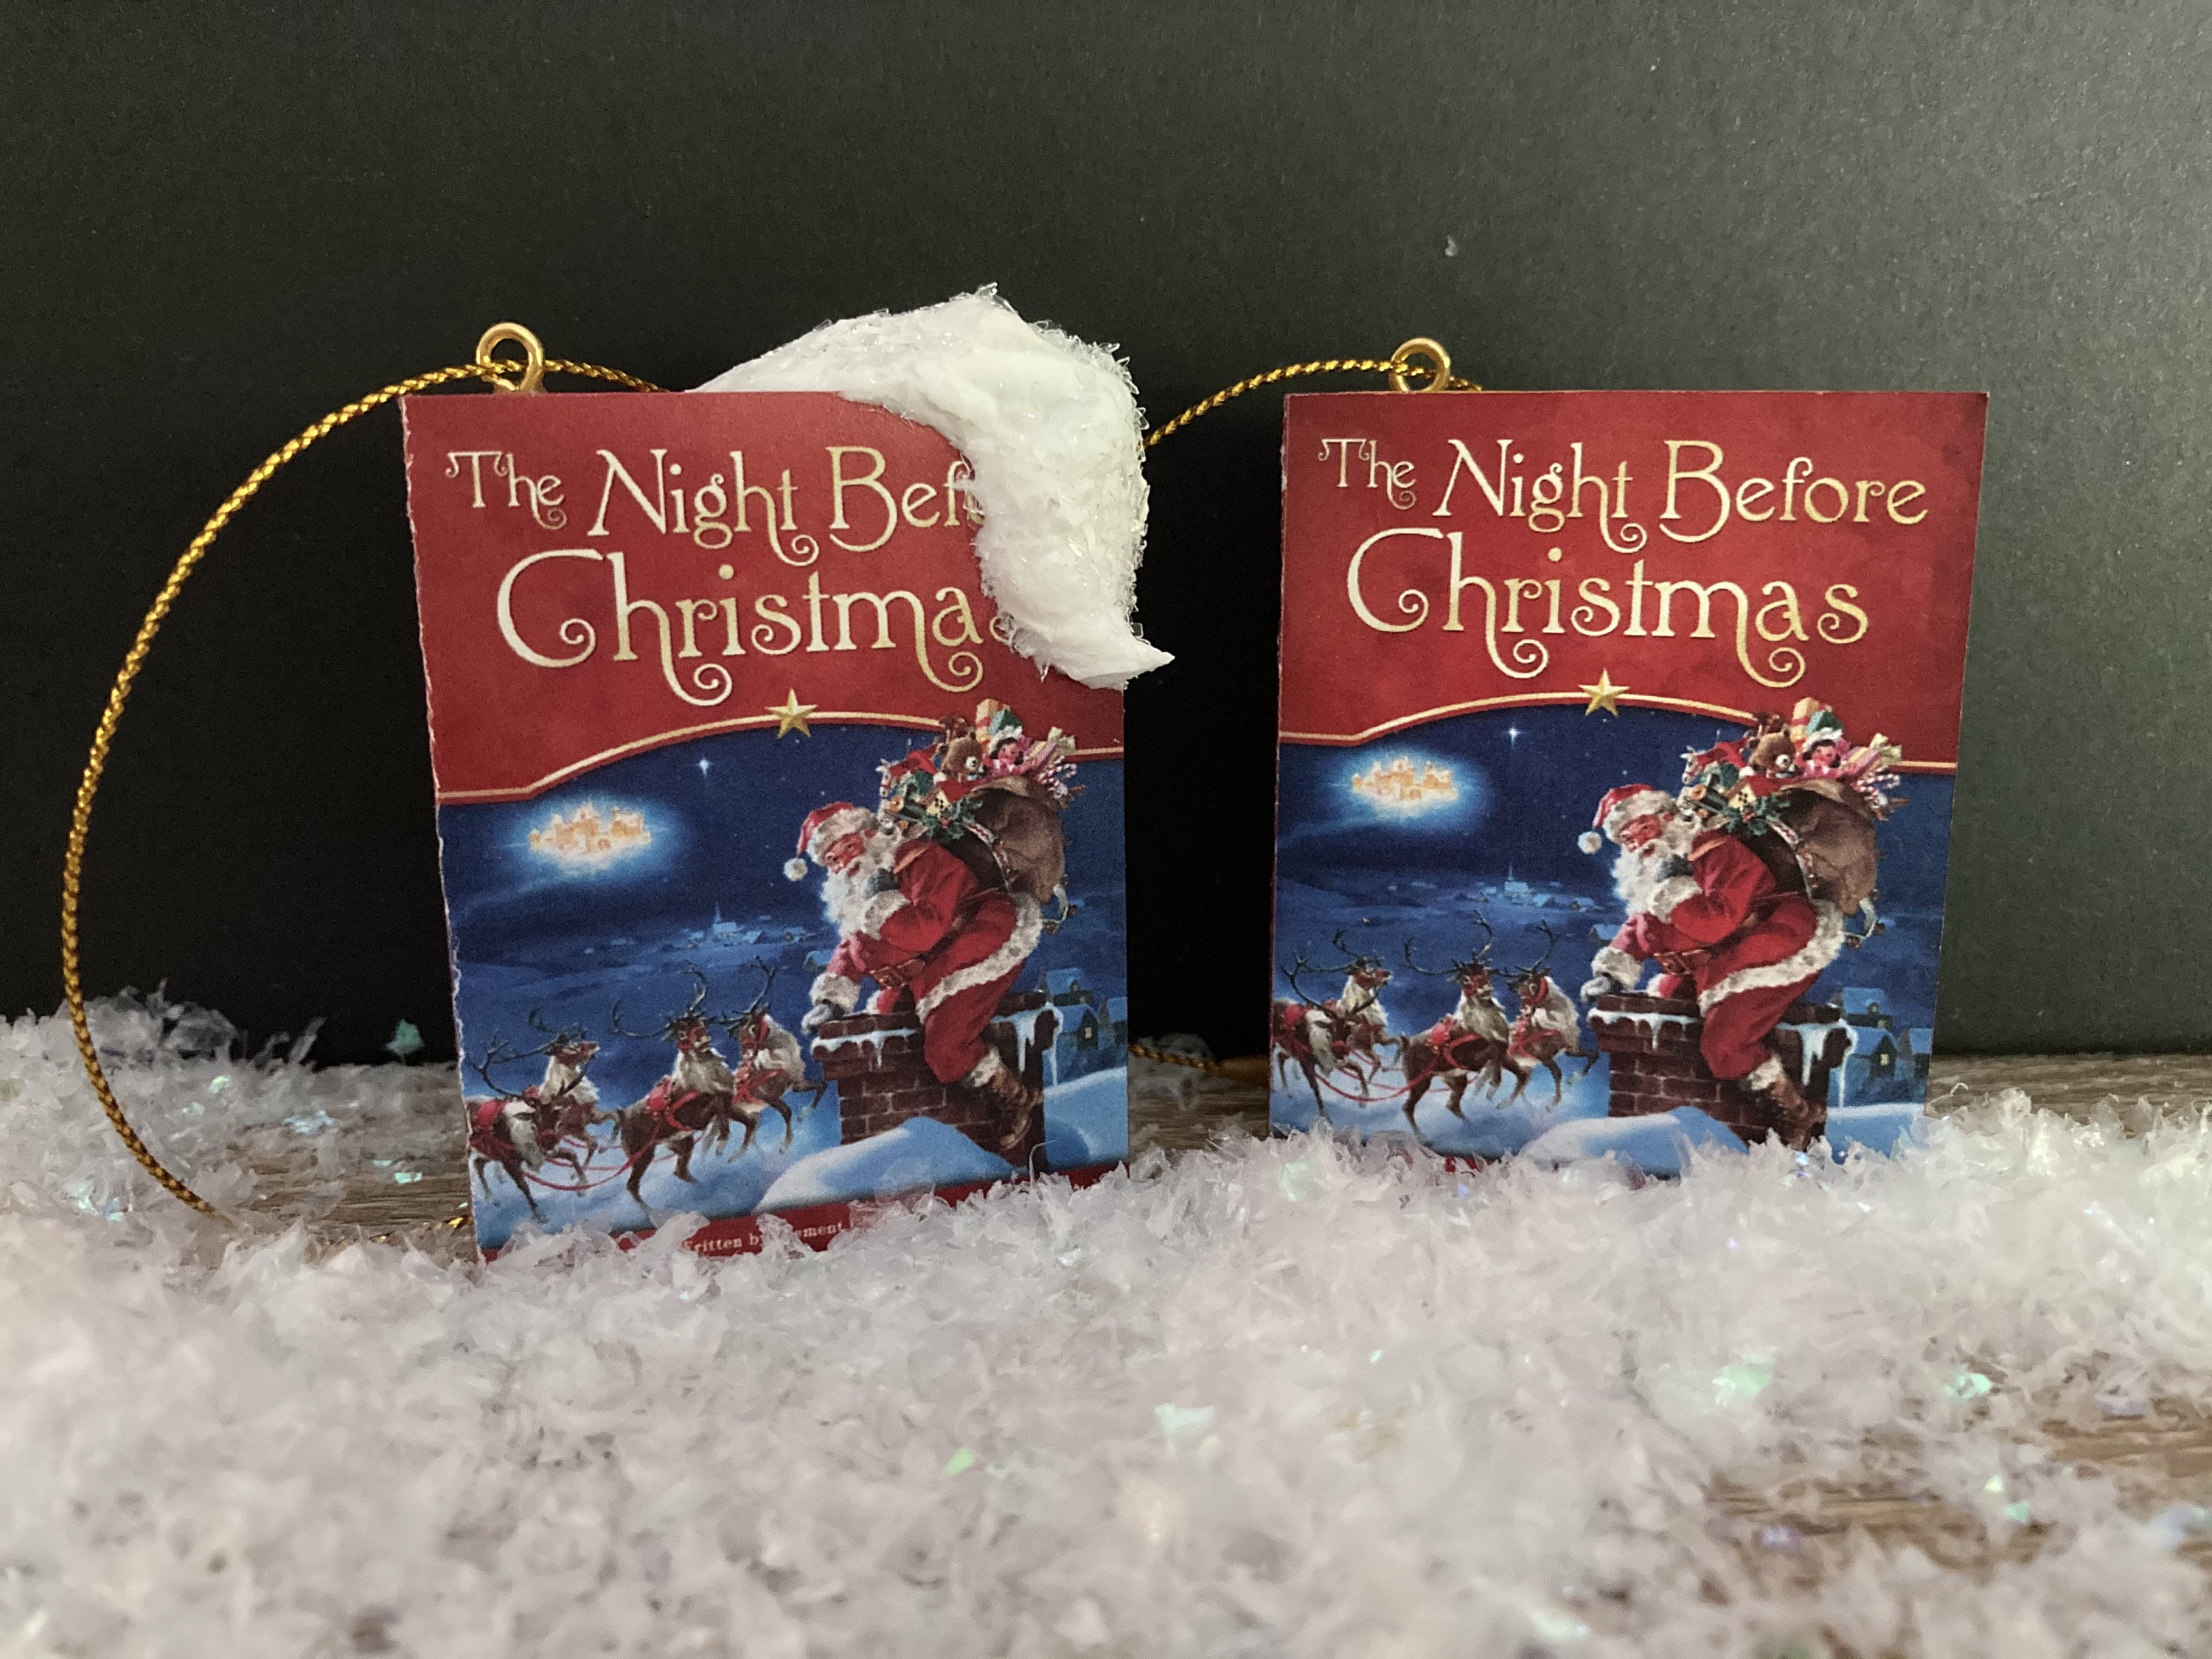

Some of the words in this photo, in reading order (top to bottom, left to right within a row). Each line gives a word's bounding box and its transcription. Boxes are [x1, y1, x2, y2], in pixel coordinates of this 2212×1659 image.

[445, 450, 567, 530] The
[586, 448, 820, 567] Night
[826, 445, 985, 553] Bef
[1318, 438, 1416, 510] The
[1431, 438, 1649, 554] Night
[1658, 439, 1929, 543] Before
[1346, 526, 1870, 689] Christmas
